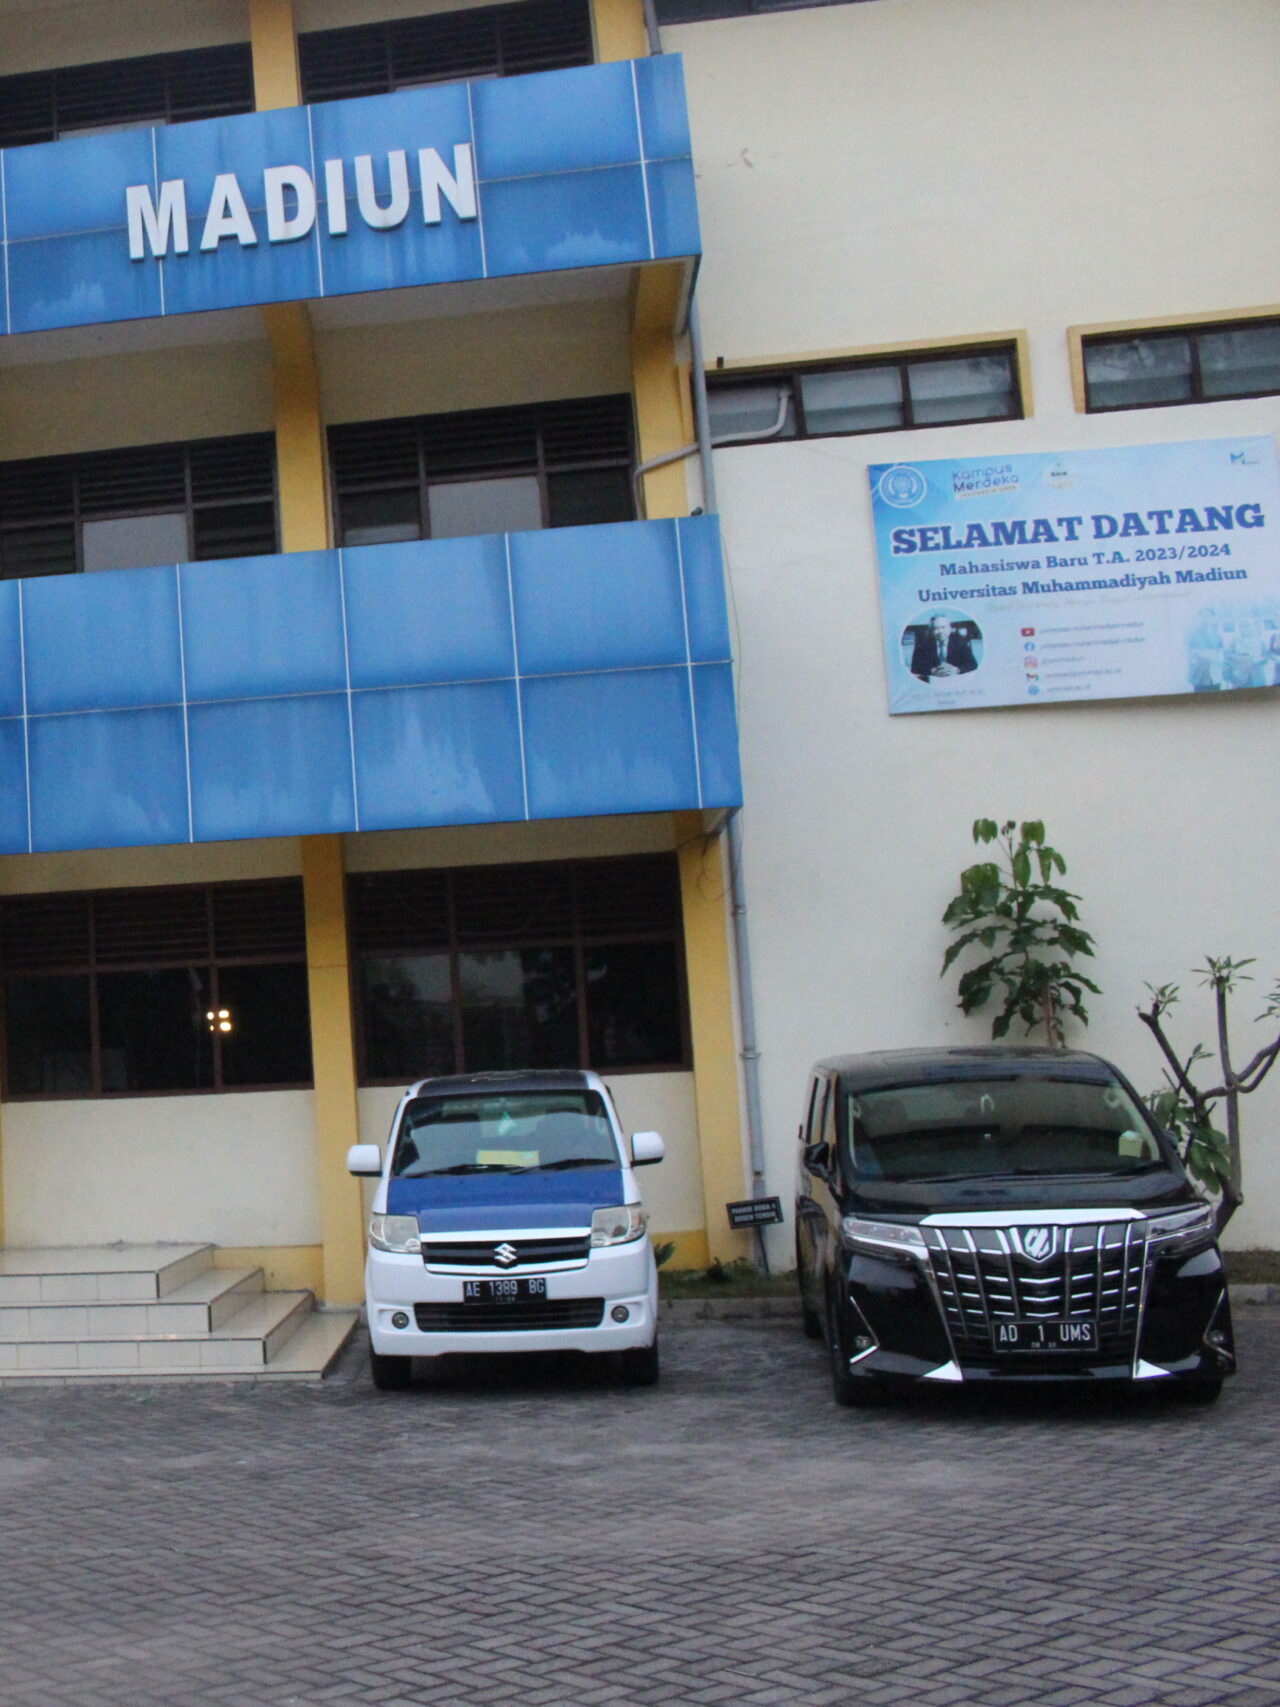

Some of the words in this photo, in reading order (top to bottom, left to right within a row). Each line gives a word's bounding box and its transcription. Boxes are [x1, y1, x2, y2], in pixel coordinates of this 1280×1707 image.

[126, 143, 477, 260] MADIUN
[952, 464, 1013, 482] Kampus
[953, 474, 1019, 493] Merdeka
[893, 515, 1083, 555] SELAMAT
[1092, 503, 1265, 539] DATANG
[940, 557, 1041, 576] Mahasiswa
[1046, 553, 1088, 569] Baru
[1092, 550, 1130, 567] T.A.
[1135, 543, 1231, 562] 2023/2024
[918, 582, 1018, 602] Universitas
[1022, 571, 1172, 595] Muhammadiyah
[1176, 567, 1247, 584] Madiun
[466, 1281, 480, 1297] AE
[489, 1280, 518, 1297] 1389
[528, 1279, 545, 1294] BG
[1000, 1324, 1018, 1342] AD
[1038, 1324, 1045, 1342] 1
[1060, 1323, 1091, 1342] UMS
